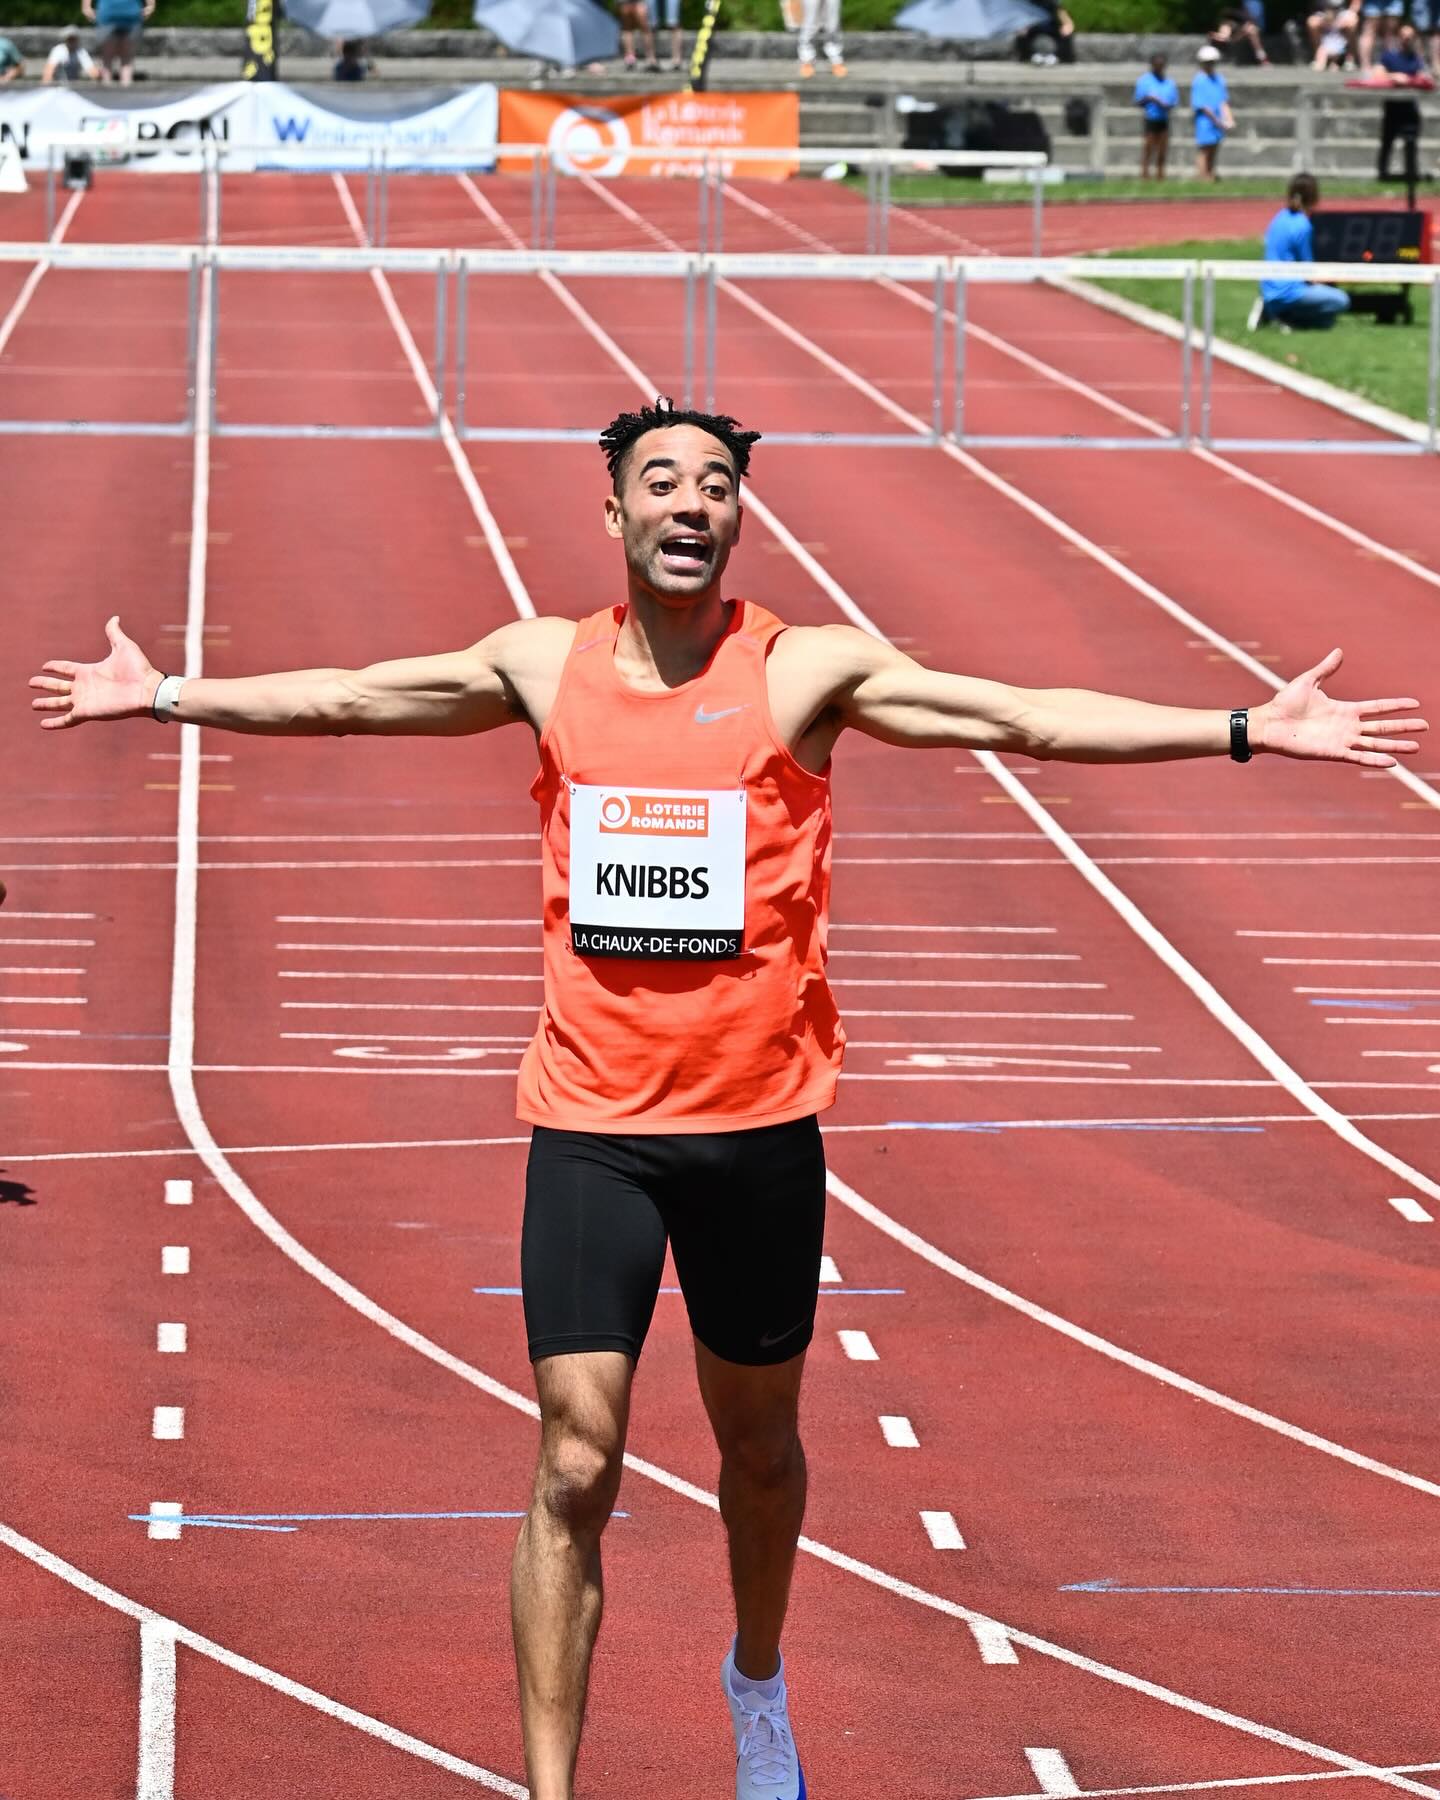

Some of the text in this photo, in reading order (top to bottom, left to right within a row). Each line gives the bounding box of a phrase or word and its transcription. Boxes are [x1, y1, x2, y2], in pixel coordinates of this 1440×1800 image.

[645, 804, 706, 816] LOTERIE
[631, 816, 705, 831] ROMANDE
[597, 863, 709, 900] KNIBBS
[574, 932, 736, 953] LA CHAUX-DE-FONDS
